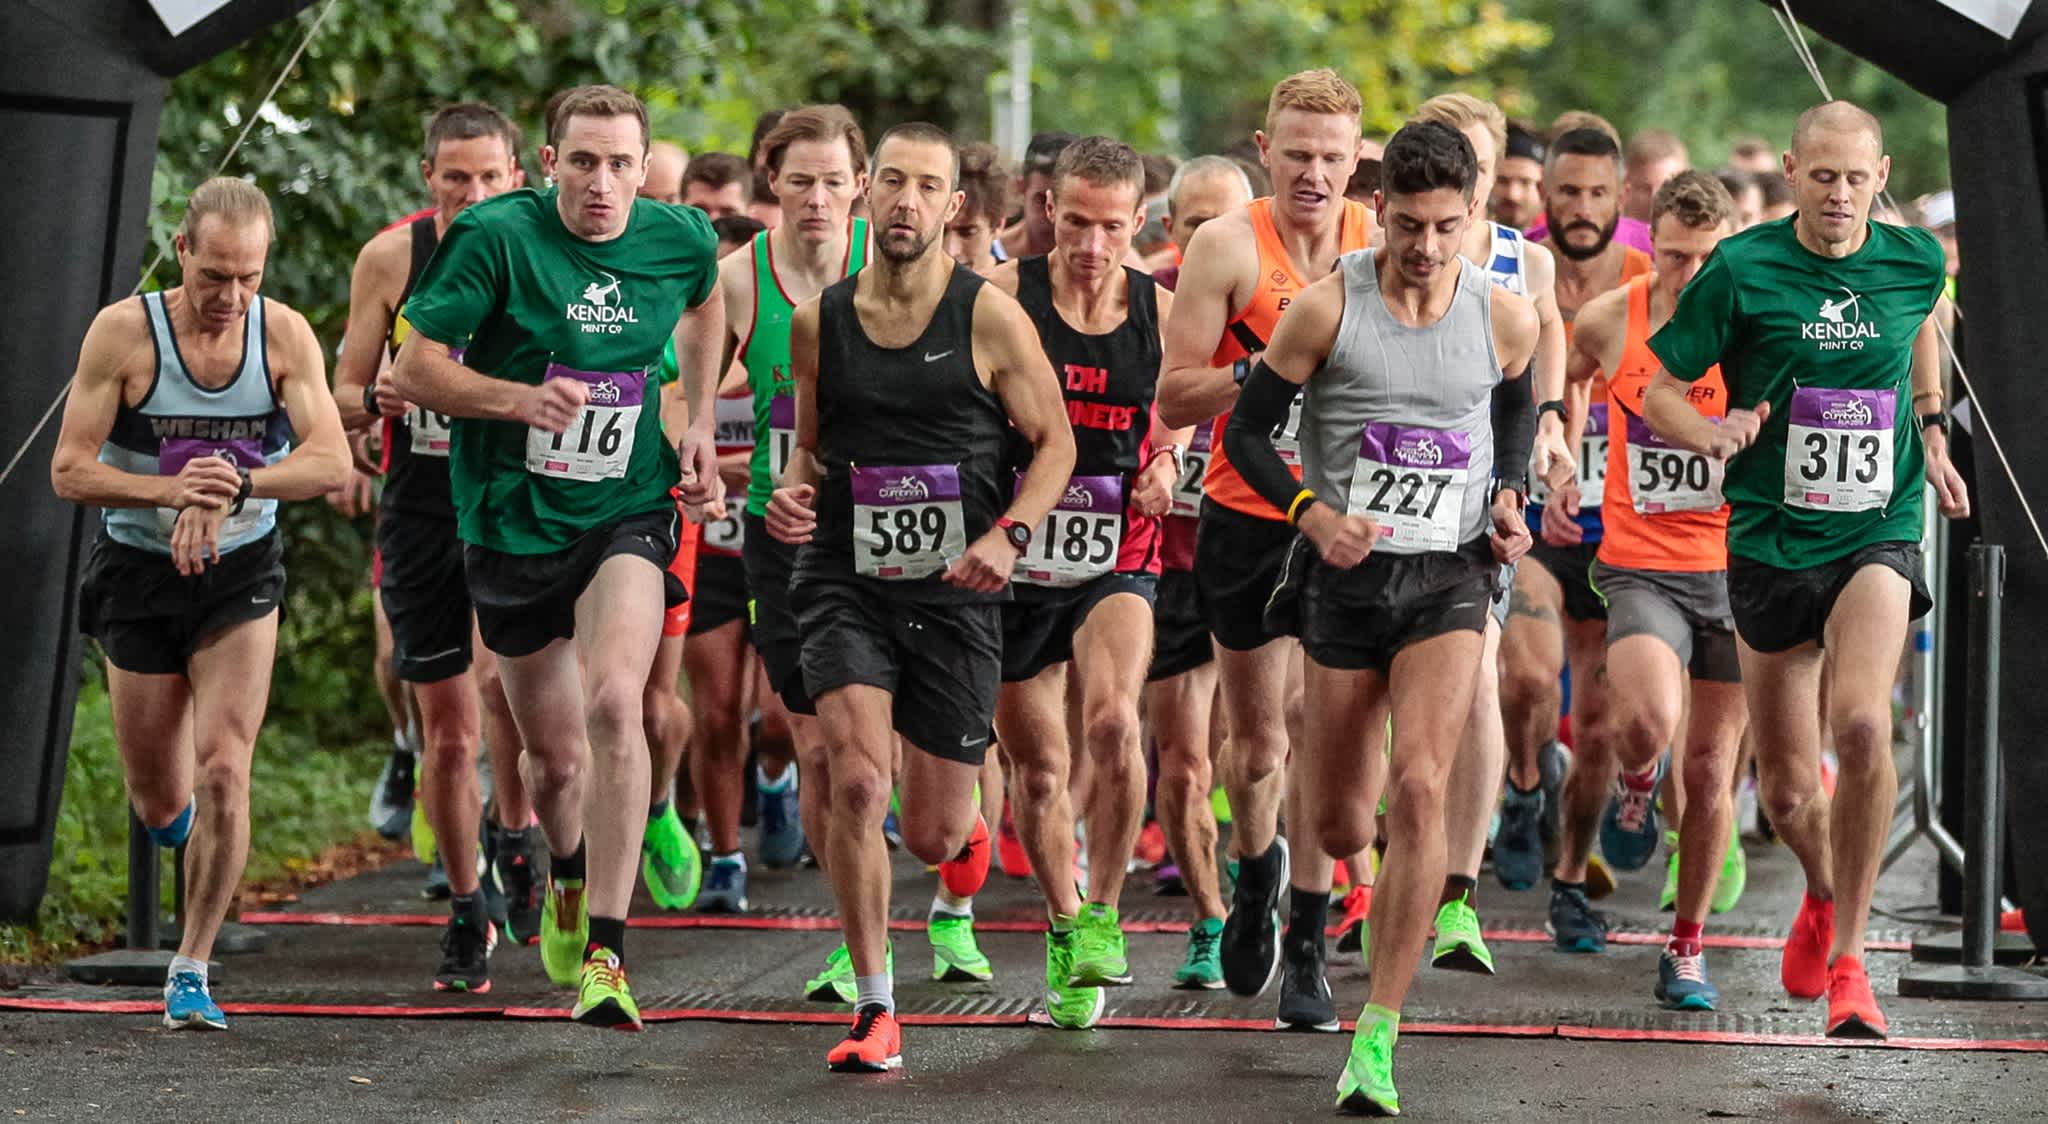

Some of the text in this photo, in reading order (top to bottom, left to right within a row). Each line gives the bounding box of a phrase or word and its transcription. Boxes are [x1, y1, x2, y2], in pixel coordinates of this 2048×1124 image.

[566, 304, 639, 323] KENDAL
[581, 323, 605, 334] MINT
[1801, 321, 1880, 339] KENDAL
[1819, 341, 1847, 351] MINT
[150, 416, 267, 439] WESHAM
[1637, 451, 1710, 492] 590
[1800, 432, 1880, 484] 313
[1366, 469, 1453, 520] 227
[869, 506, 947, 557] 589
[1043, 514, 1115, 565] 185
